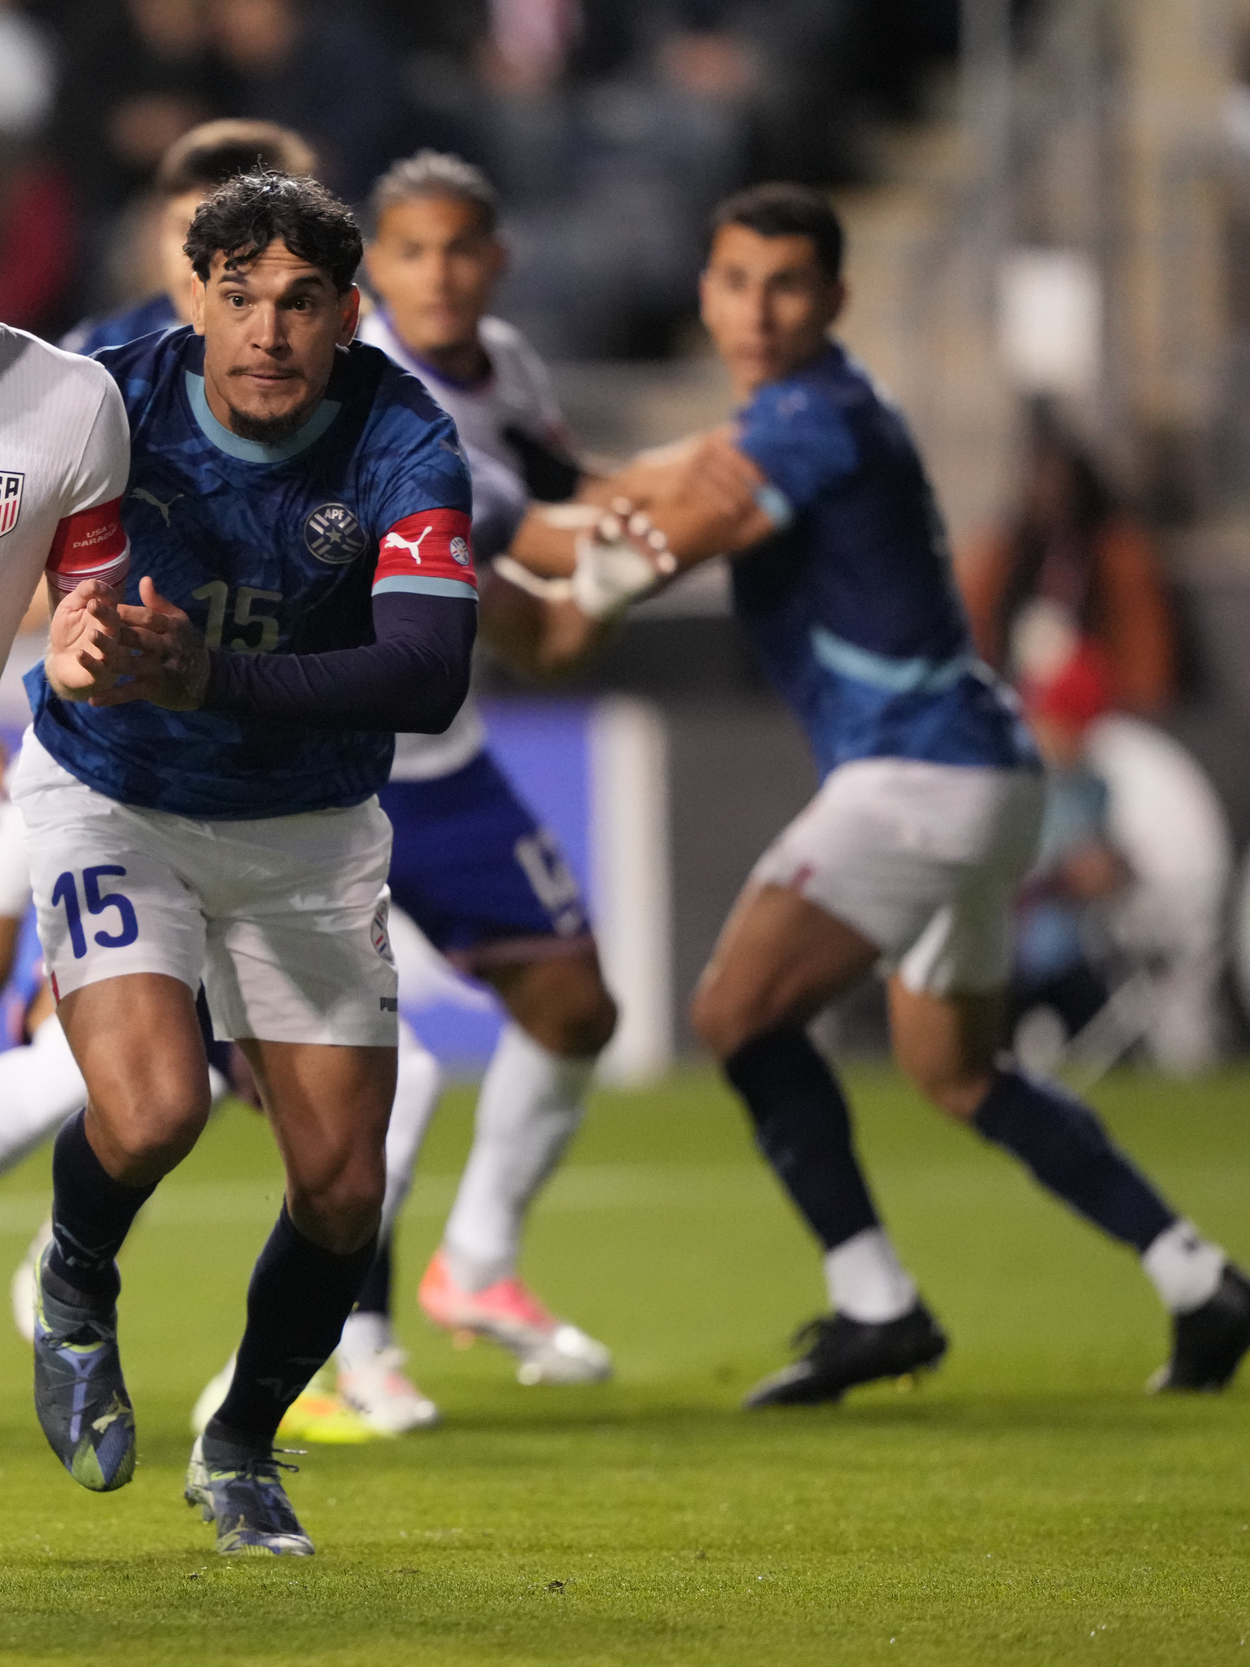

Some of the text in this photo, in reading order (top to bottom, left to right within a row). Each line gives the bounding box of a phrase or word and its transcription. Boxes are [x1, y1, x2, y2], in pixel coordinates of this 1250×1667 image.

[86, 526, 108, 539] USA
[324, 508, 345, 521] APF
[191, 579, 284, 654] 15
[51, 864, 139, 960] 15
